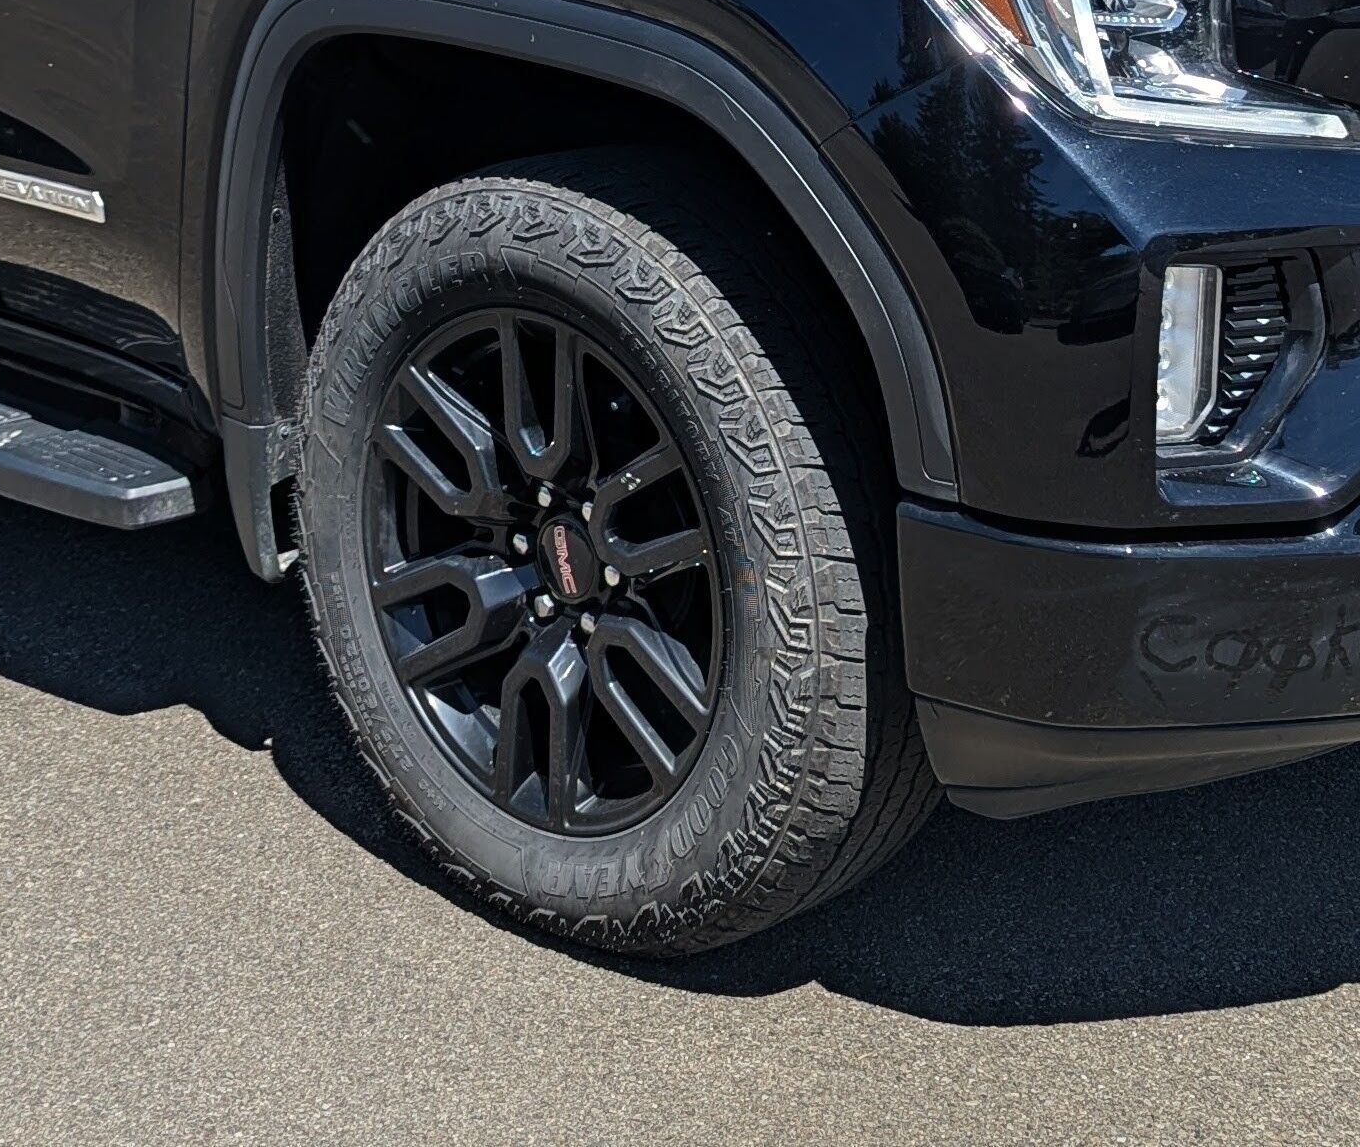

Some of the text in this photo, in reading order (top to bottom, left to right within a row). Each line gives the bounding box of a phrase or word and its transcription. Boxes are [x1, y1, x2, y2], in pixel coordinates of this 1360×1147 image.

[322, 251, 490, 427] WRANGLER
[554, 525, 577, 595] GMC
[542, 733, 740, 899] GOODYEAR
